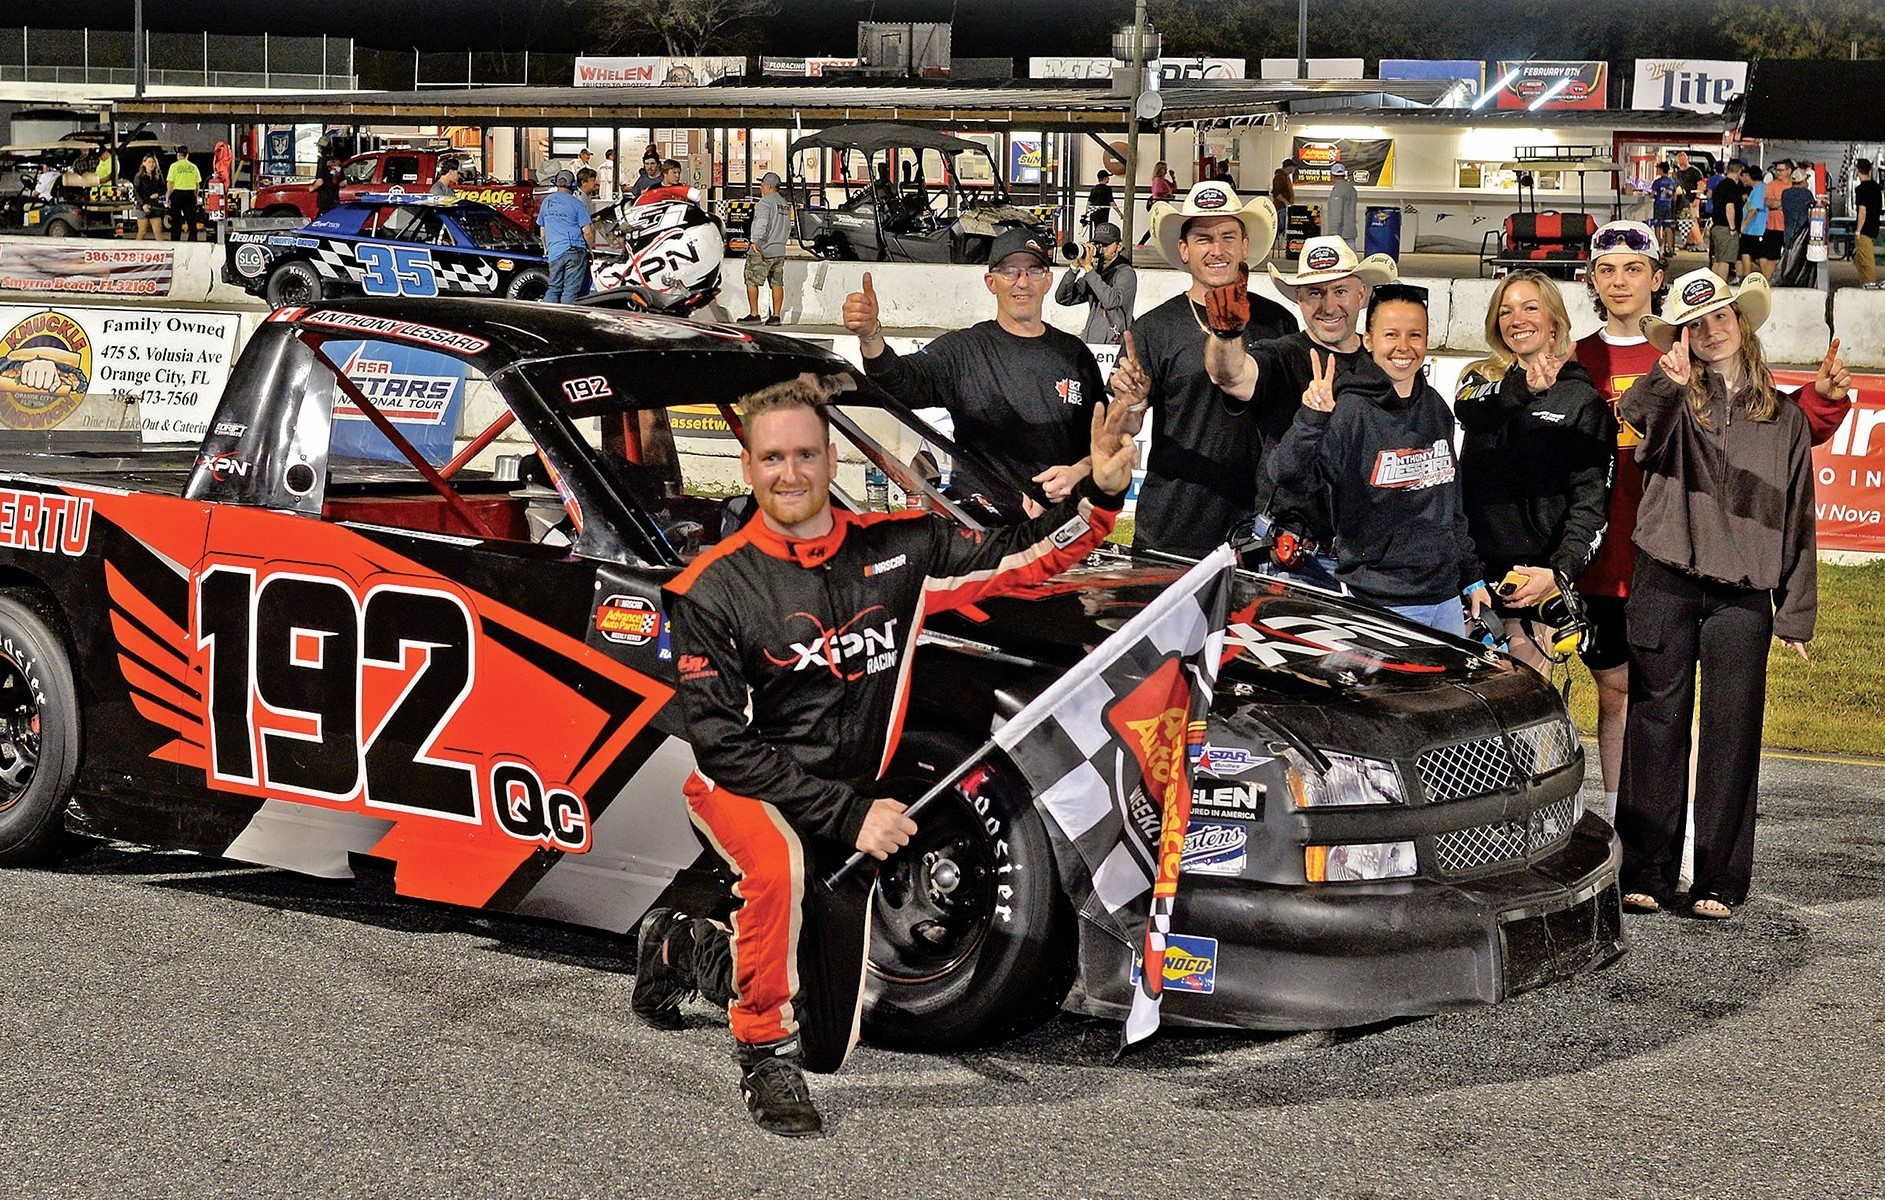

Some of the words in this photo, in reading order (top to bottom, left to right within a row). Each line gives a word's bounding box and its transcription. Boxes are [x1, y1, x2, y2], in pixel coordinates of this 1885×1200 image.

[580, 65, 653, 81] WHELEN
[769, 62, 805, 70] FLORACING
[1523, 67, 1563, 77] FEBRUARY
[1645, 62, 1686, 80] Miller
[1660, 70, 1735, 109] Lite
[229, 232, 267, 244] DEBARY
[239, 253, 260, 265] SLG
[356, 243, 438, 298] 35
[1, 277, 52, 291] Smyrna
[53, 280, 98, 292] Beach,
[100, 280, 114, 291] FL
[116, 280, 157, 294] 32168
[6, 317, 86, 351] KNUCKLE
[102, 317, 162, 334] Family
[167, 317, 225, 339] Owned
[310, 310, 401, 334] ANTHONY
[399, 321, 486, 352] LESSARD
[101, 345, 125, 361] 475
[128, 346, 141, 361] S.
[147, 345, 193, 363] Volusia
[197, 348, 223, 364] Ave
[100, 366, 151, 384] Orange
[155, 368, 186, 387] City,
[191, 370, 211, 385] FL
[357, 360, 389, 375] ASA
[564, 377, 611, 400] 192
[408, 398, 443, 410] TOUR
[1067, 392, 1083, 406] 192
[142, 417, 160, 431] Out
[161, 419, 170, 431] &
[173, 419, 209, 434] Caterin
[200, 452, 248, 477] XPN
[1379, 451, 1434, 468] ANTHONY
[1829, 503, 1881, 524] Nova
[874, 553, 907, 575] NASCAR
[600, 619, 619, 630] Auto
[619, 621, 640, 632] Parts
[604, 609, 642, 624] Advance
[789, 617, 897, 672] XPN
[866, 649, 898, 675] RACIN
[196, 564, 482, 826] 192
[1208, 750, 1247, 761] STAR
[490, 760, 592, 851] QC
[1221, 811, 1256, 820] AMERICA
[1183, 826, 1240, 850] ostens
